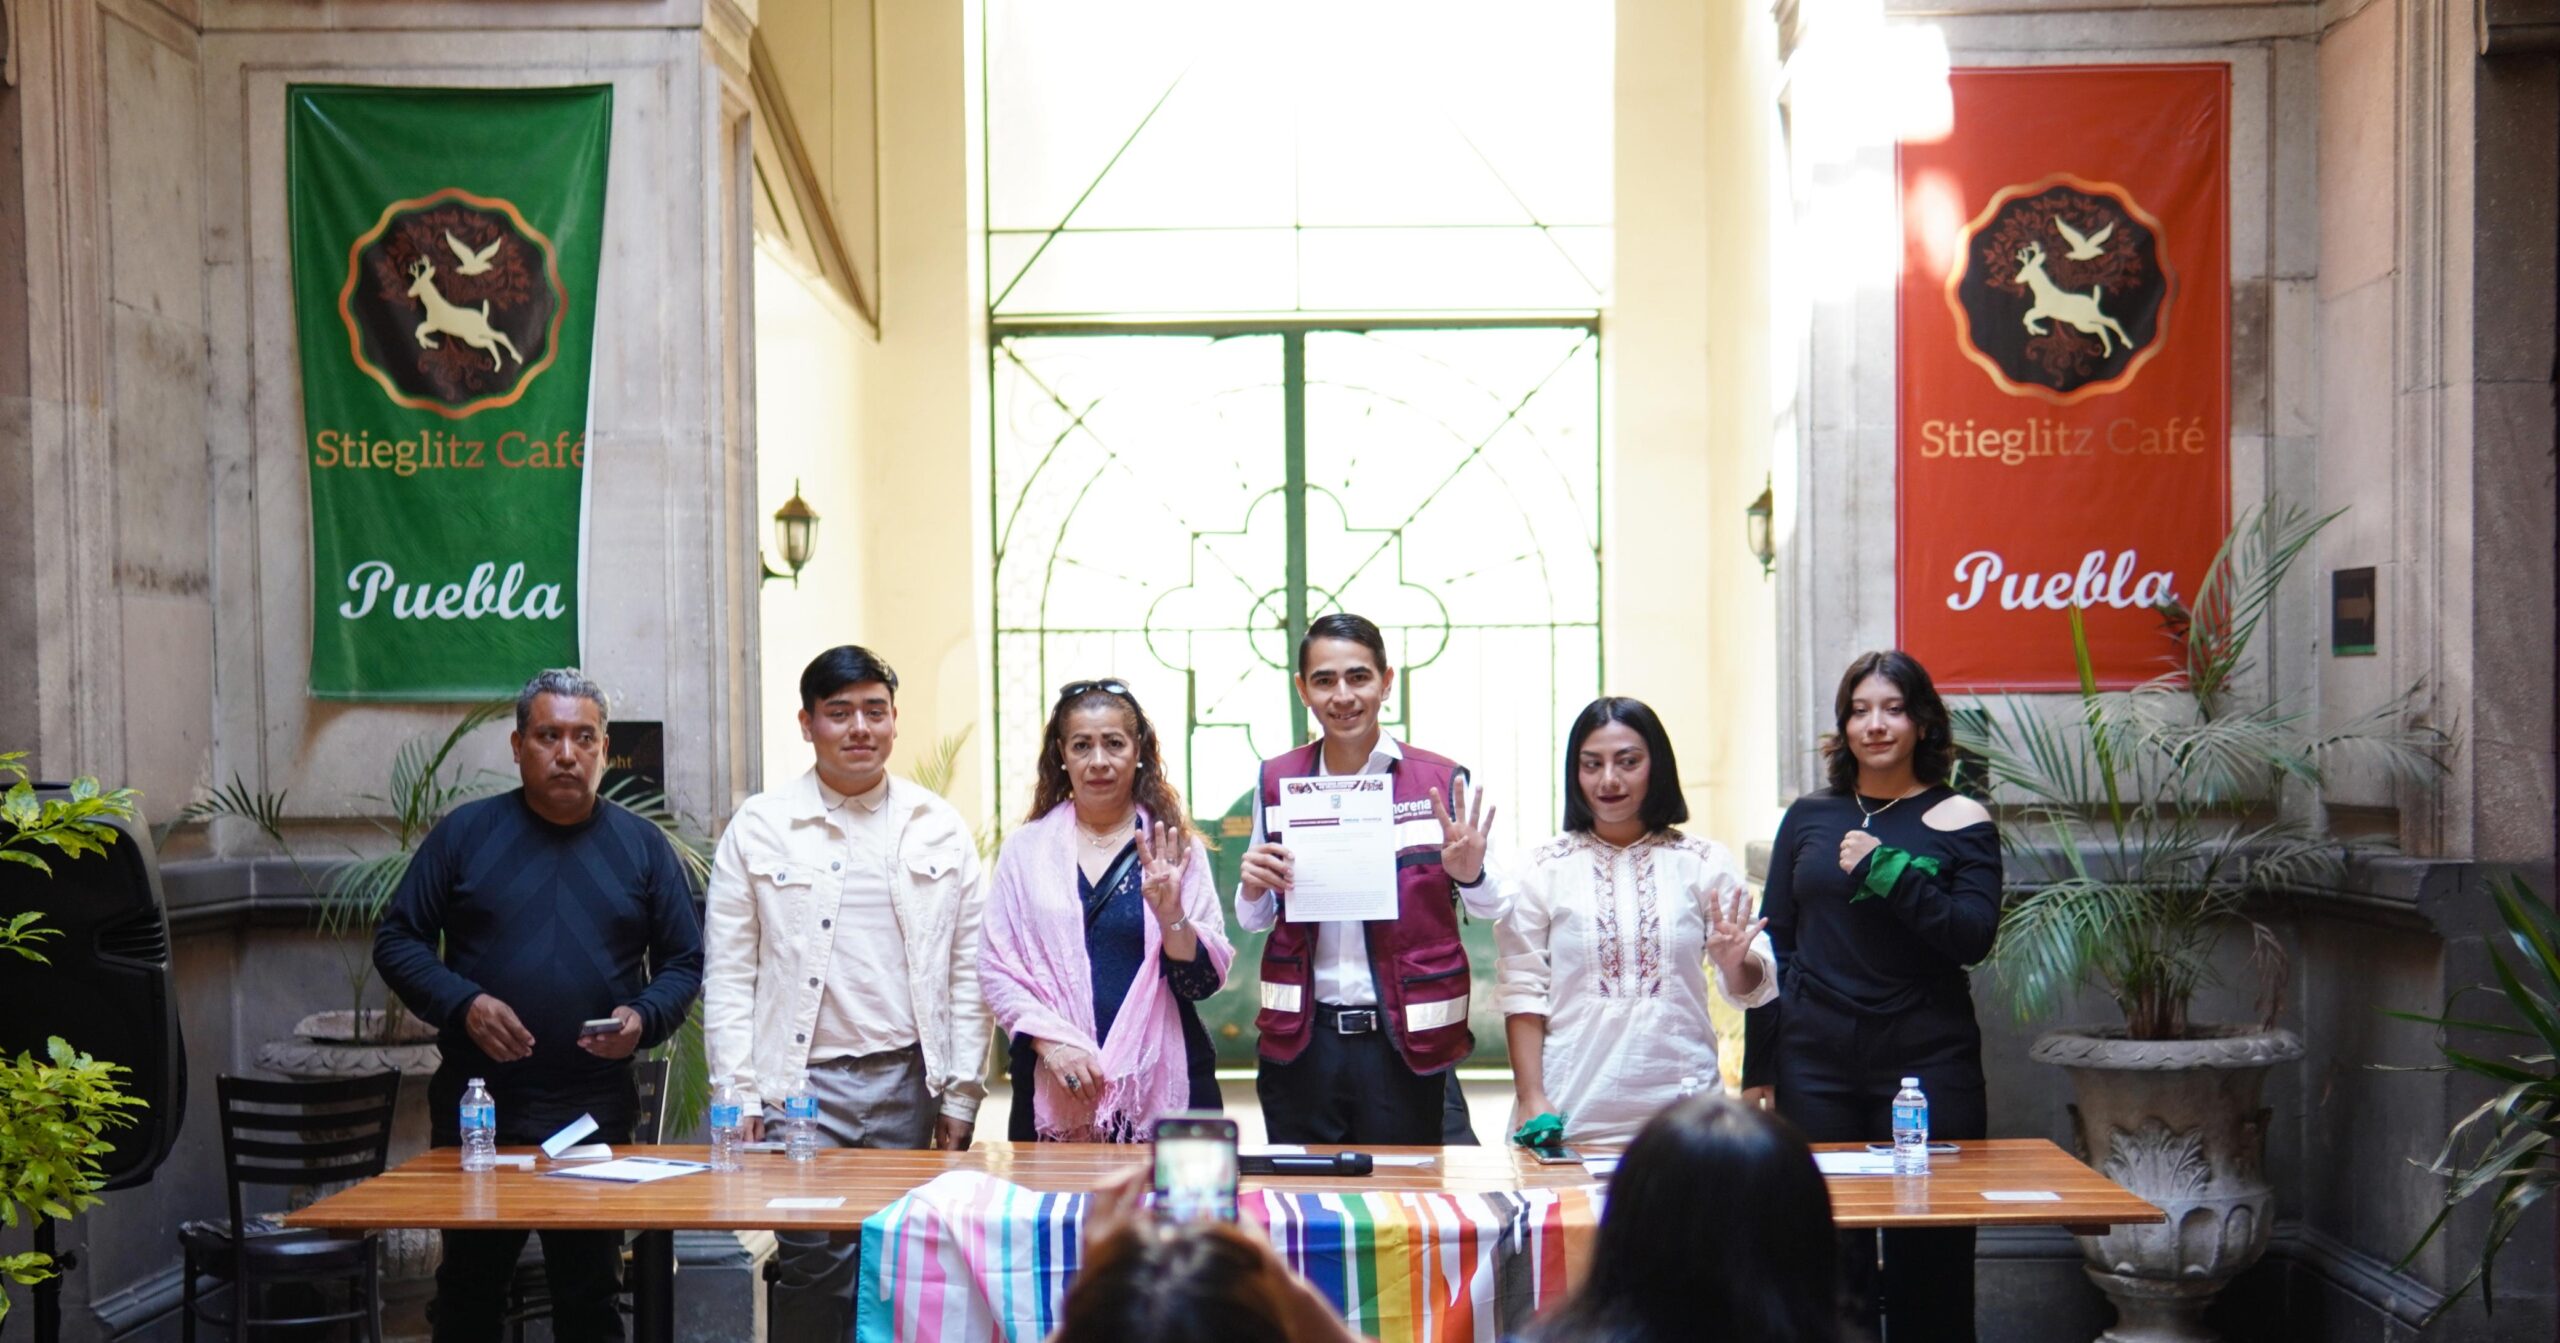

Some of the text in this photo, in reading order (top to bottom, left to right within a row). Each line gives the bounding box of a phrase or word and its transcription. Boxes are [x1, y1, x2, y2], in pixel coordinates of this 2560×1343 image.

[315, 430, 484, 476] Stieglitz
[1920, 417, 2205, 465] Stieglitz Café
[339, 560, 565, 619] Puebla
[1947, 550, 2178, 610] Puebla
